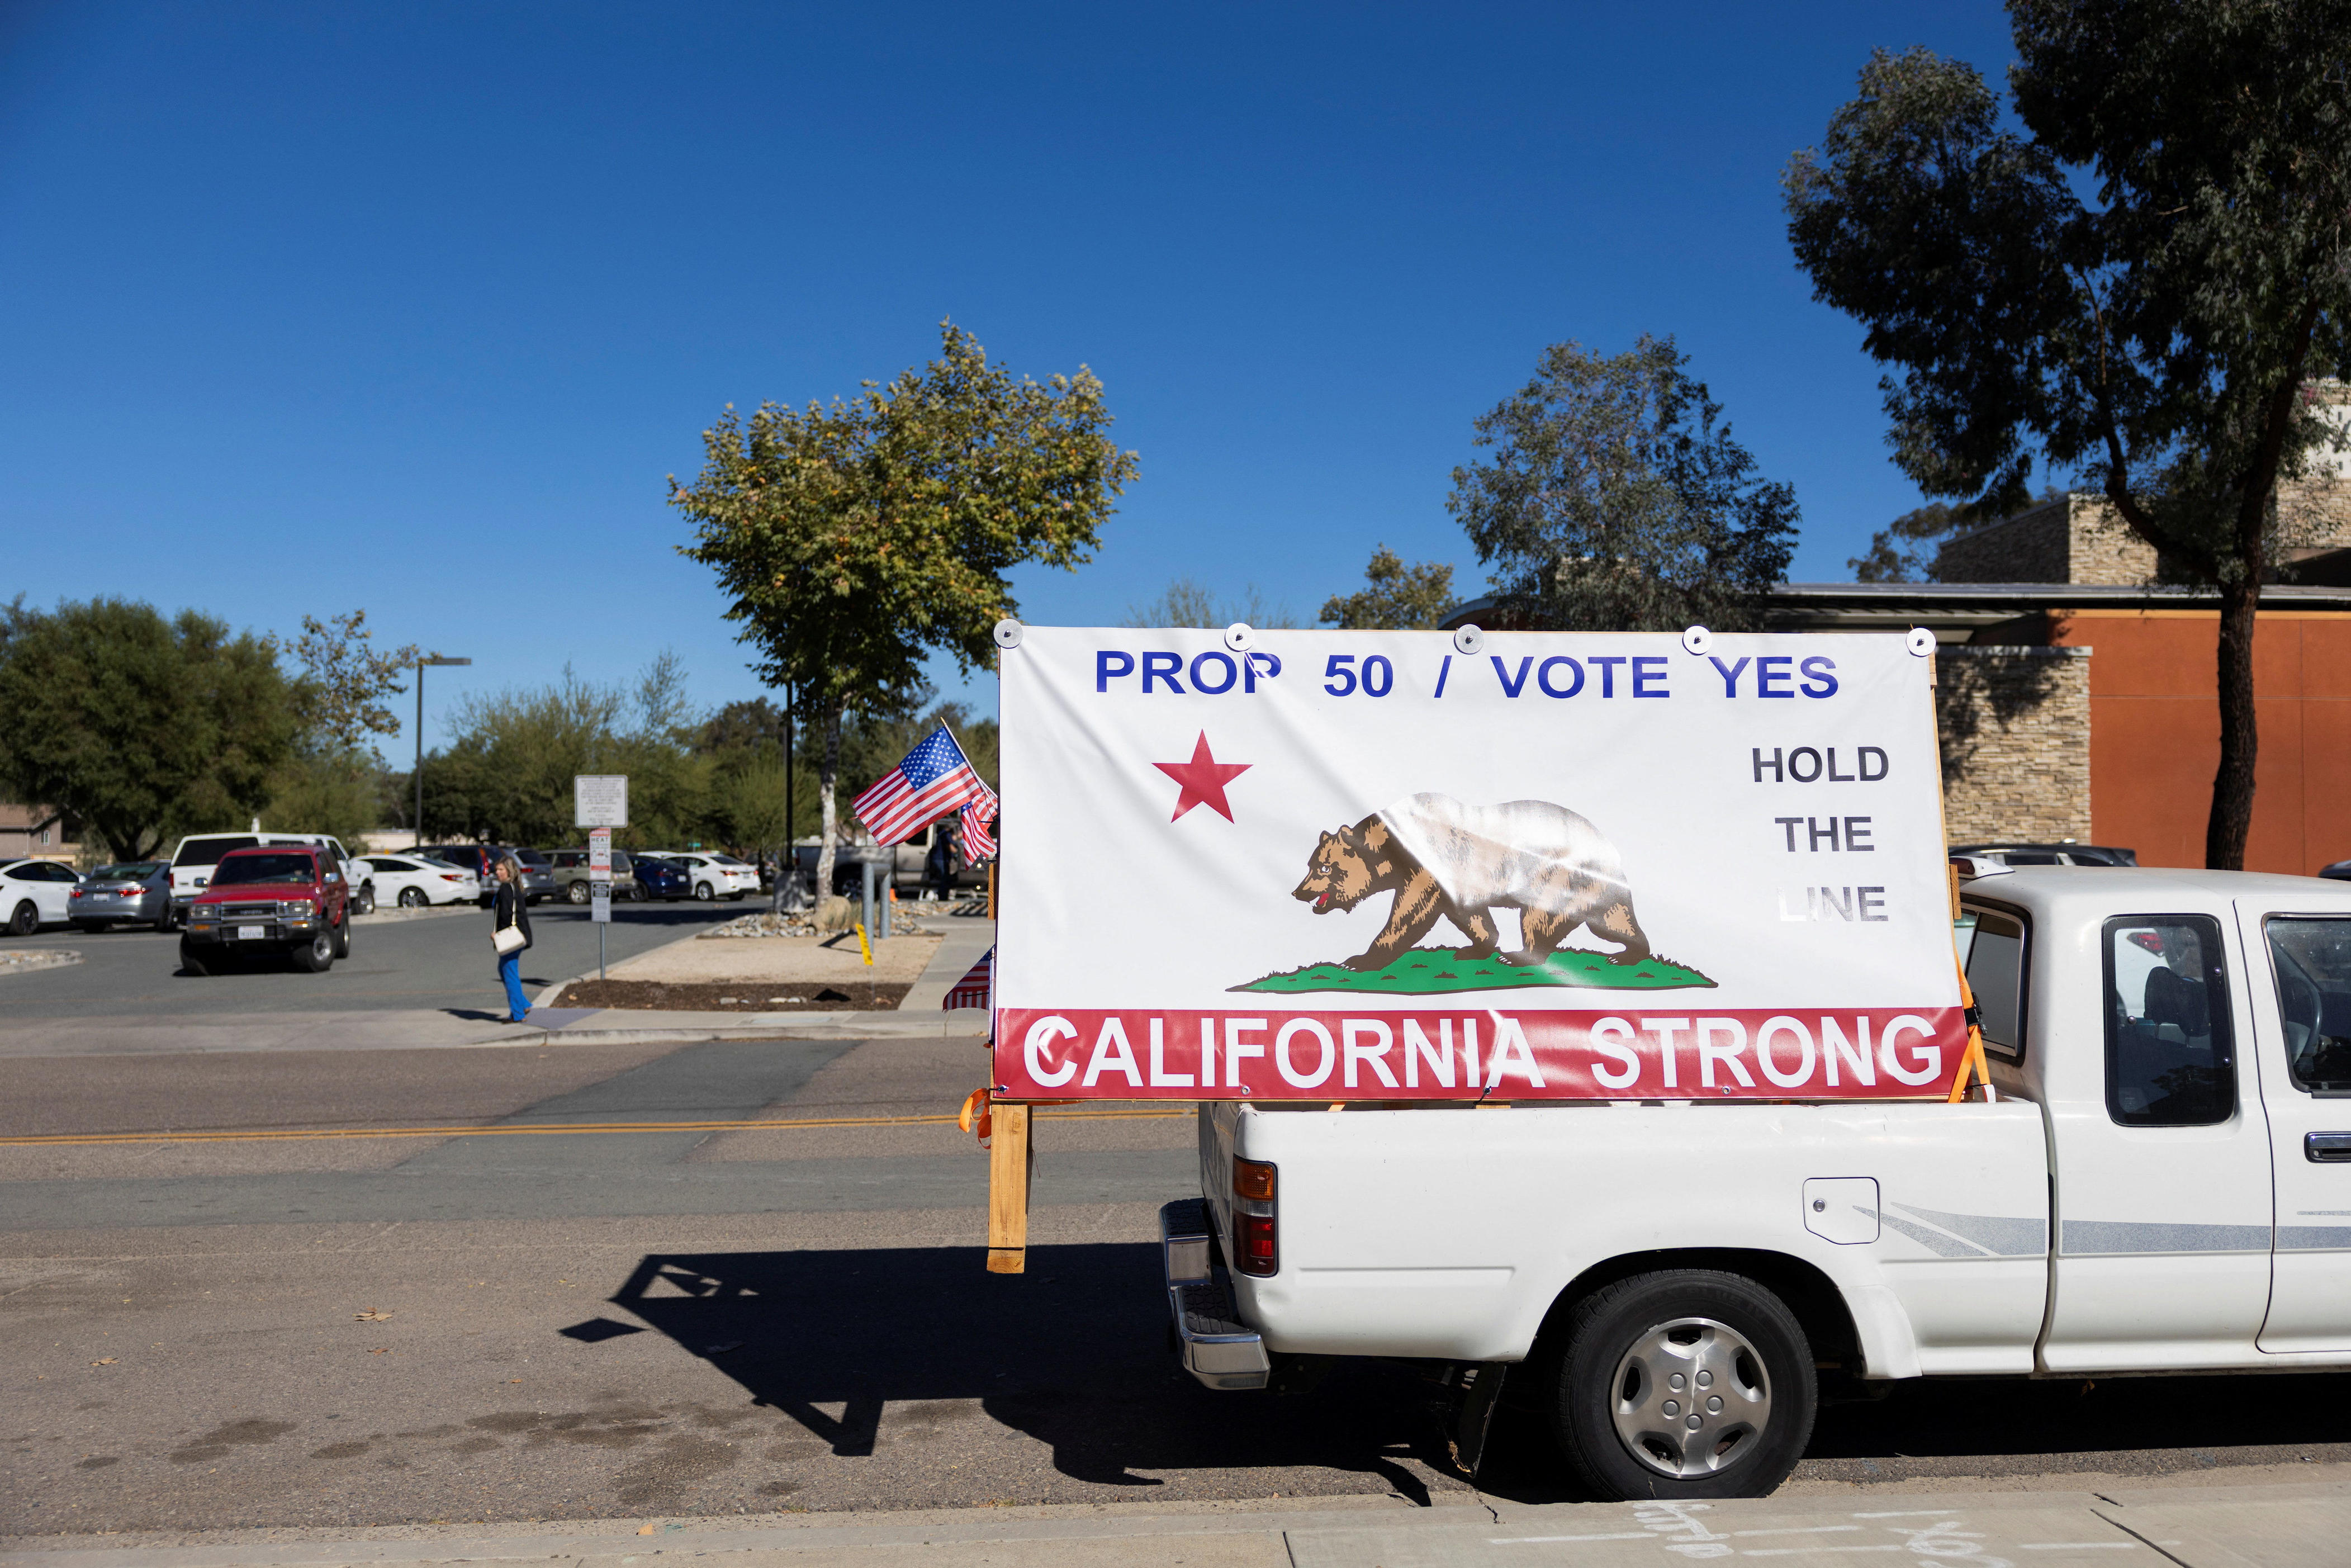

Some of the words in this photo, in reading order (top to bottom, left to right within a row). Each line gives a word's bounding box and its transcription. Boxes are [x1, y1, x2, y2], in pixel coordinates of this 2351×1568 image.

[1097, 651, 1282, 694] PROP
[1324, 655, 1393, 698] 50
[1434, 656, 1452, 698] /
[1490, 656, 1670, 699] VOTE
[1709, 657, 1839, 699] YES
[1752, 746, 1889, 783] HOLD
[1775, 817, 1875, 852] THE
[1778, 887, 1889, 922] LINE
[1024, 1015, 1546, 1088] CALIFORNIA
[1591, 1015, 1942, 1089] STRONG
